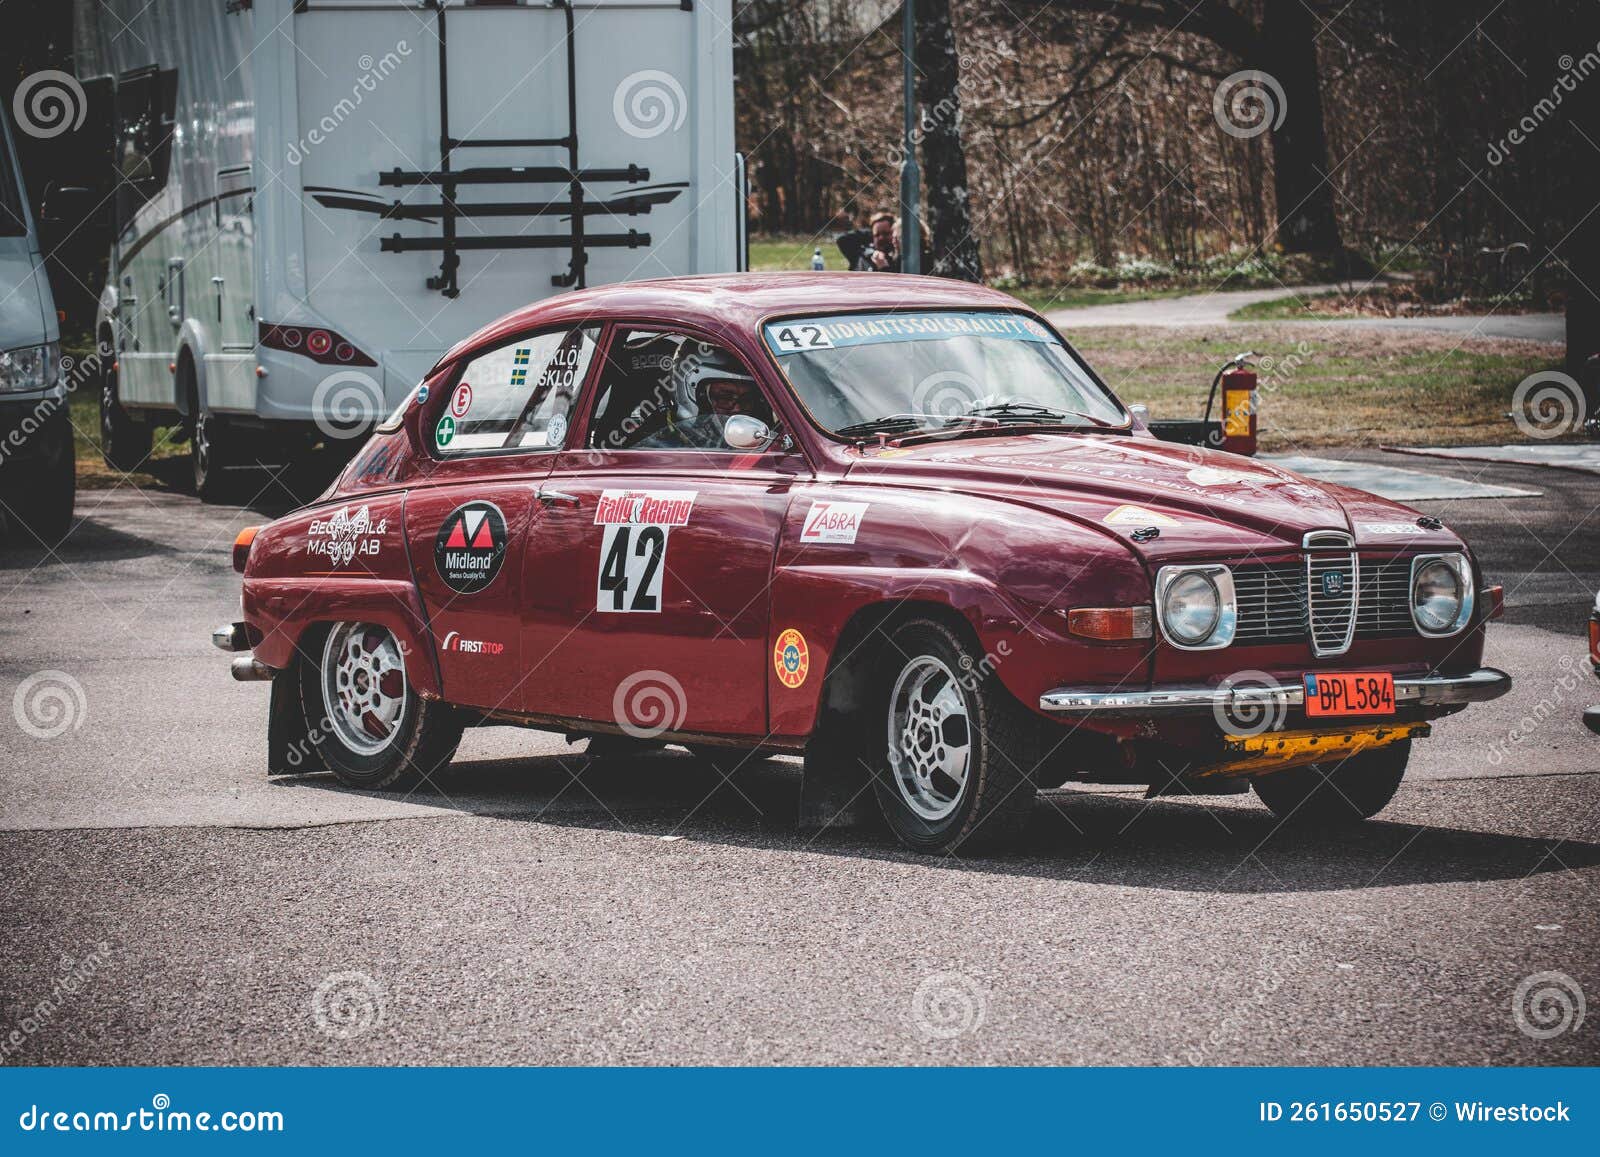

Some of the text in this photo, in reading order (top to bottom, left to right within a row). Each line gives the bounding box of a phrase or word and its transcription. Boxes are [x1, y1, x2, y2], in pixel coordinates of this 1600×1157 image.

[778, 326, 829, 348] 42
[596, 497, 635, 524] Rally
[639, 496, 692, 525] Racing
[804, 503, 856, 537] ZABRA
[358, 540, 380, 555] AB
[445, 552, 491, 569] Midland
[599, 526, 665, 611] 42
